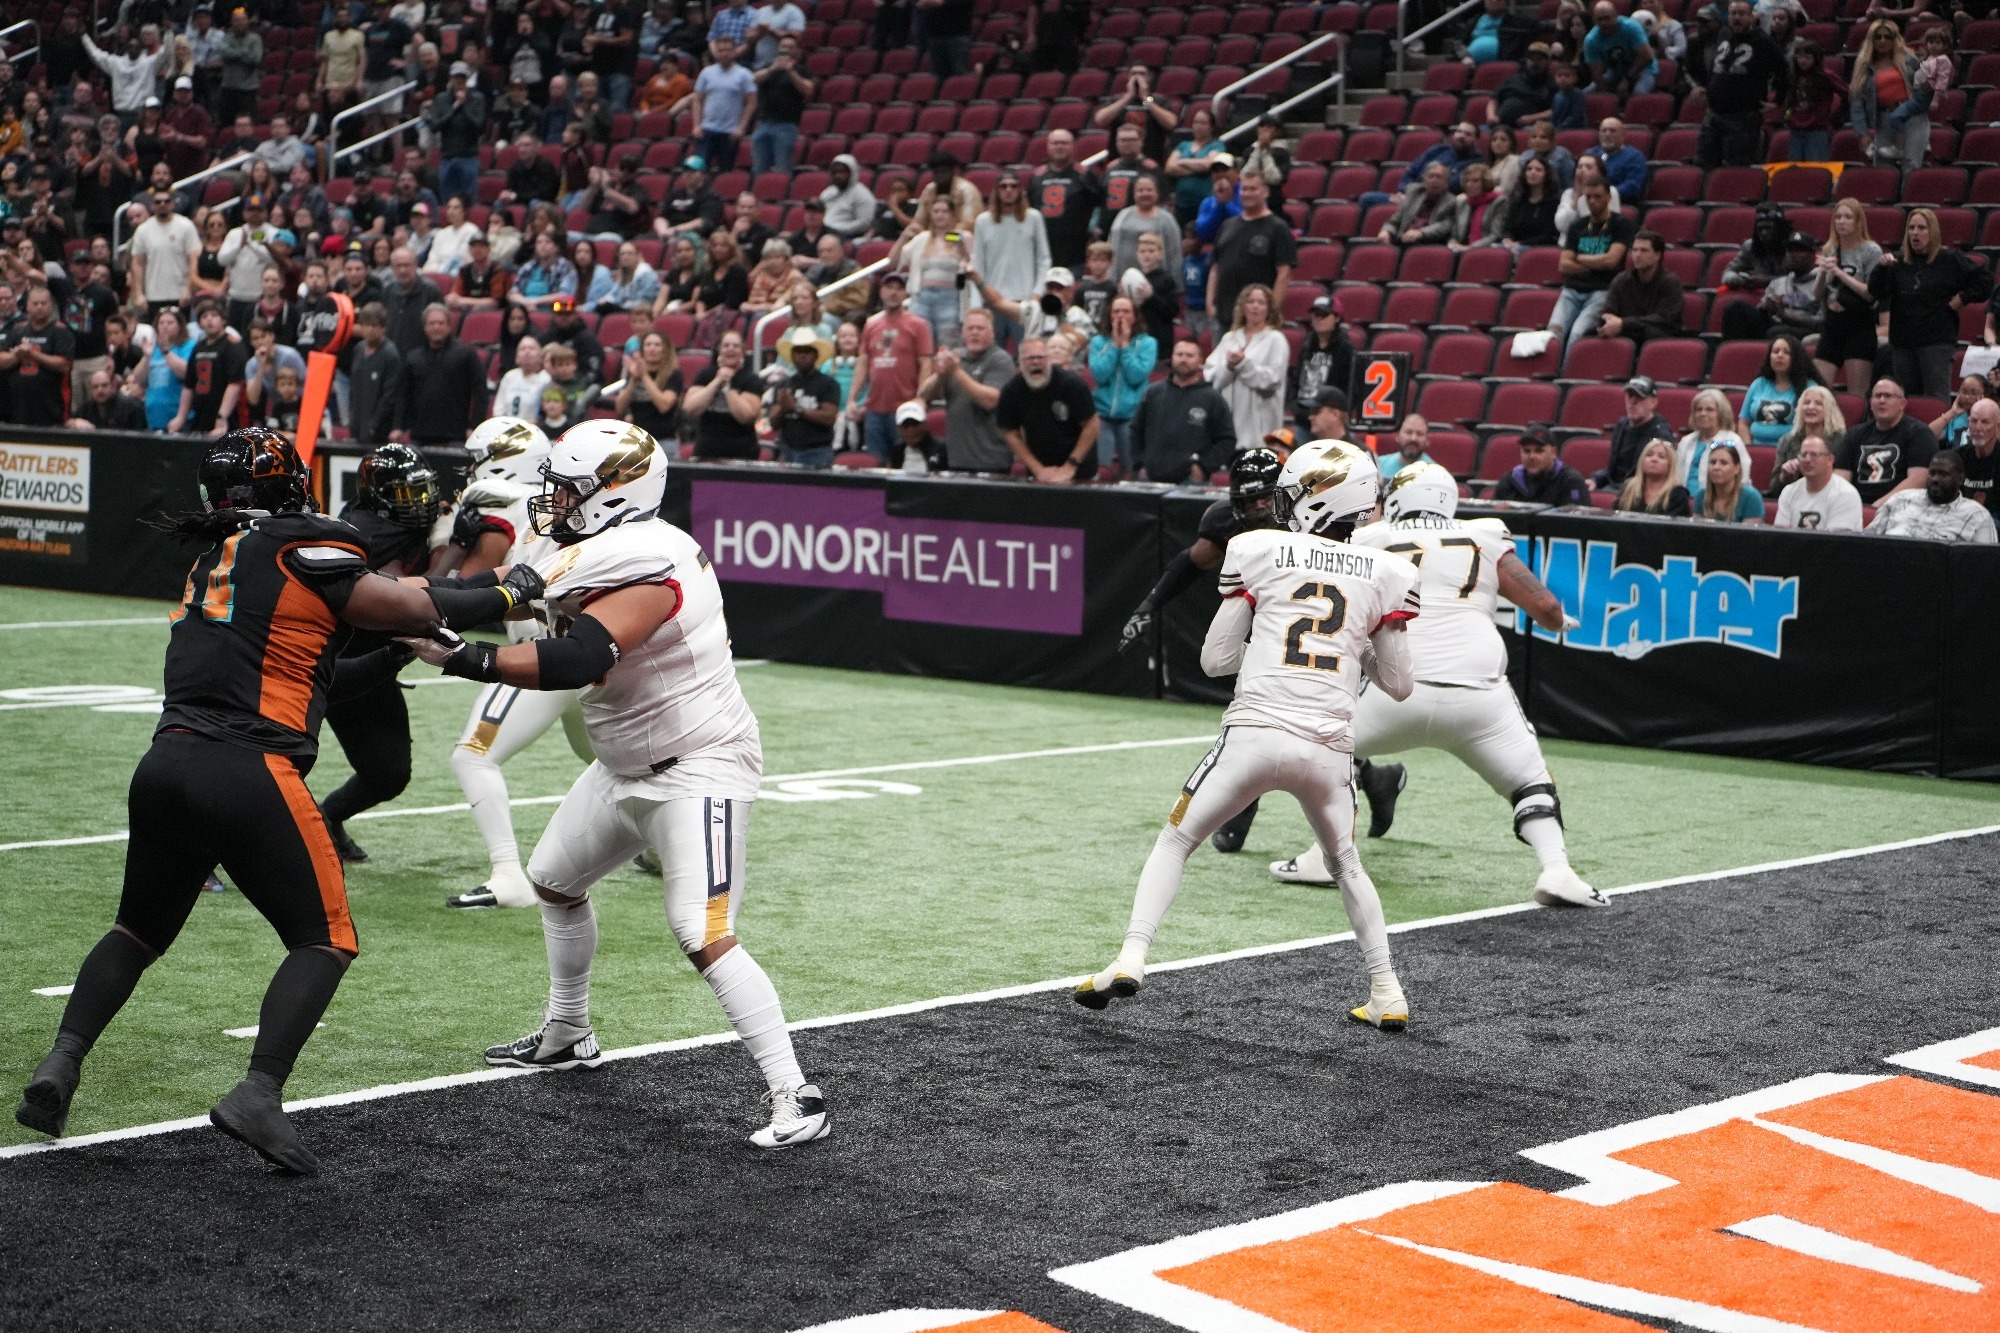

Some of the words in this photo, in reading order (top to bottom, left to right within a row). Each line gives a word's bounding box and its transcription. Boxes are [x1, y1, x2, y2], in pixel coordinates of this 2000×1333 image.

[1712, 40, 1753, 74] 22
[1041, 185, 1066, 217] 9
[1106, 177, 1129, 209] 9
[1362, 360, 1397, 418] 2
[1275, 545, 1299, 569] JA.
[1304, 547, 1374, 581] JOHNSON
[1281, 581, 1348, 673] 2
